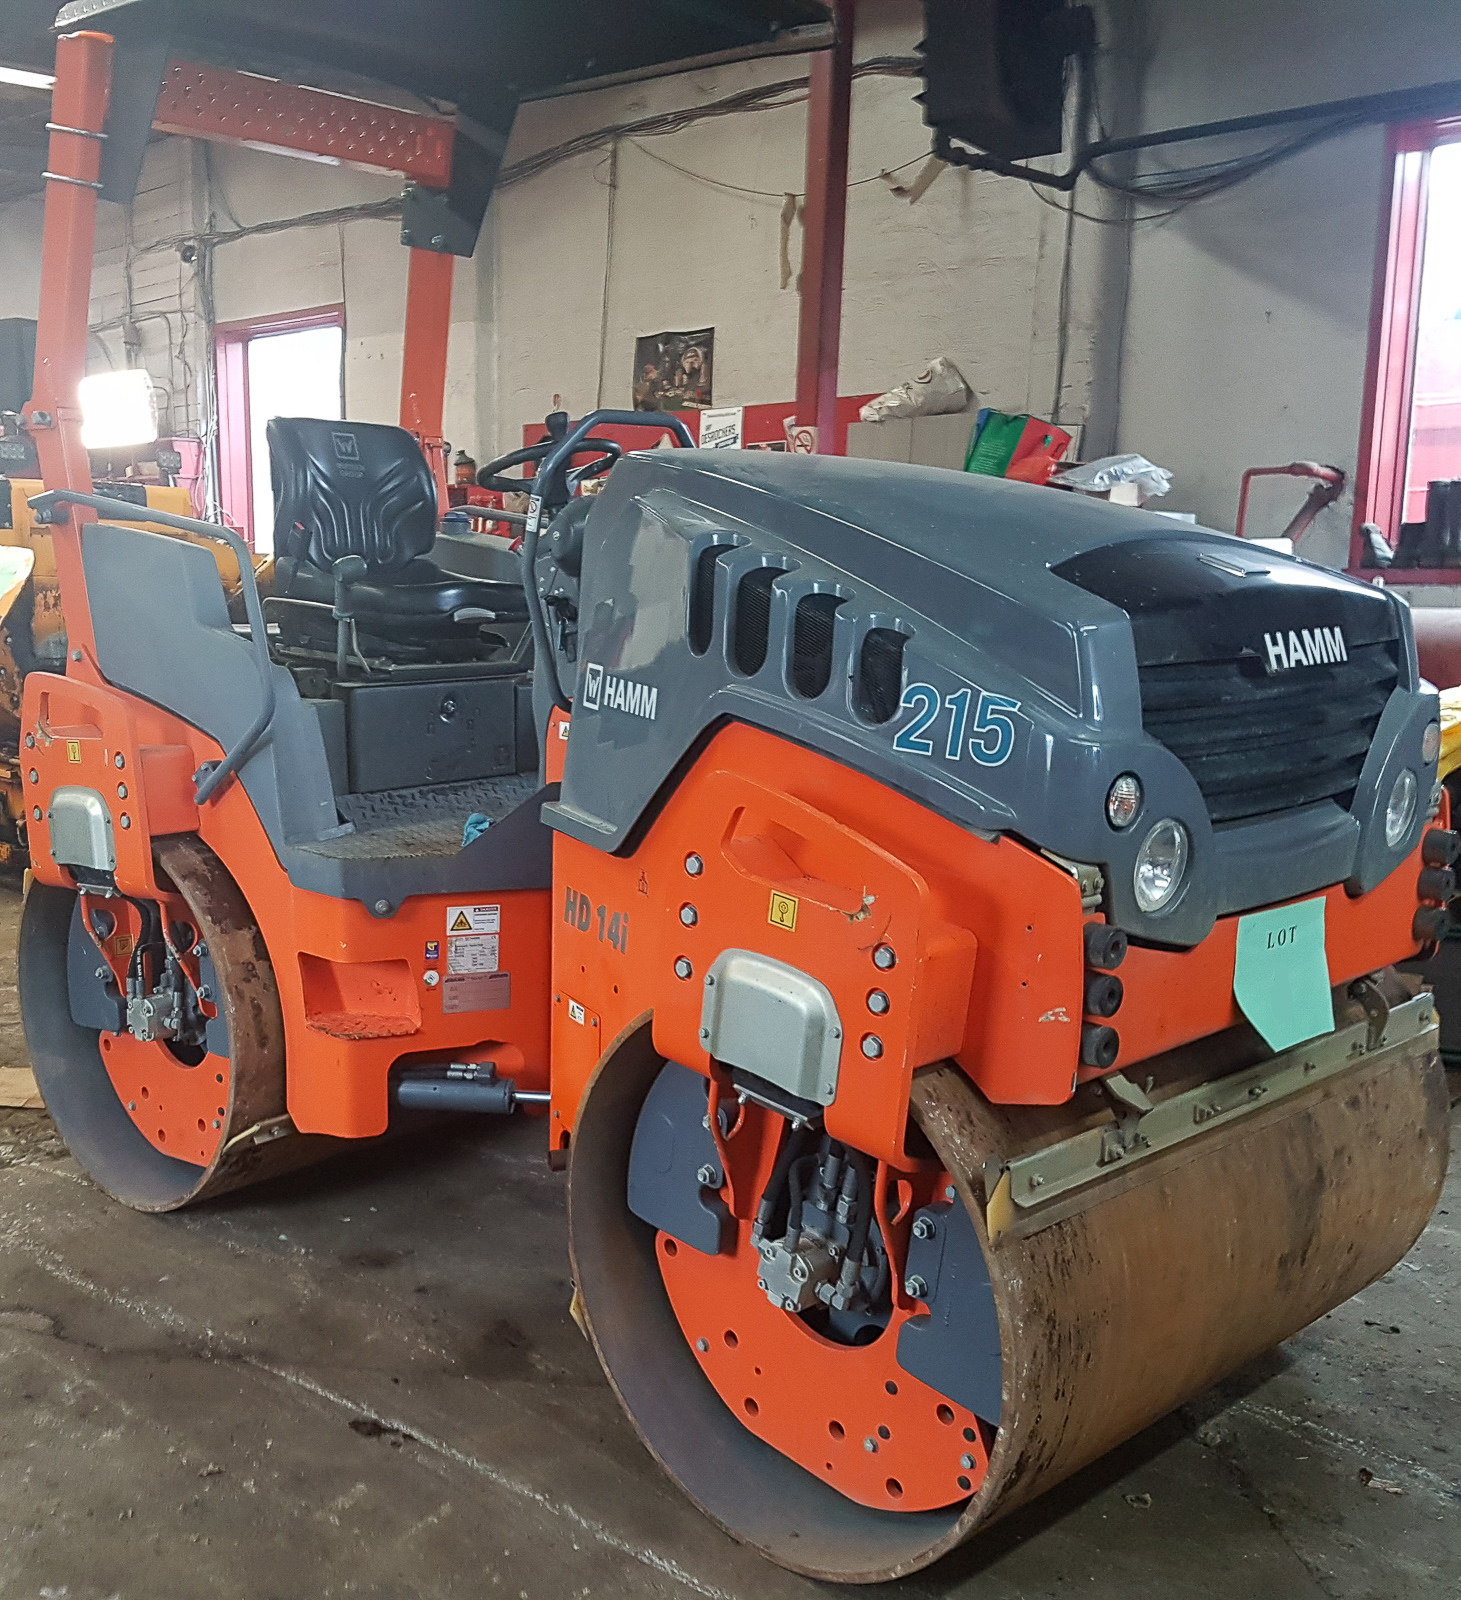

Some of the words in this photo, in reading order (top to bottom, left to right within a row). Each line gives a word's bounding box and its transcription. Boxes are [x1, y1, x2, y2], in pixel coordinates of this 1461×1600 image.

[1263, 625, 1348, 671] HAMM
[604, 675, 658, 720] HAMM
[893, 682, 1022, 767] 215
[563, 886, 592, 932] HD
[597, 904, 629, 955] 14i
[1266, 925, 1298, 950] LOT
